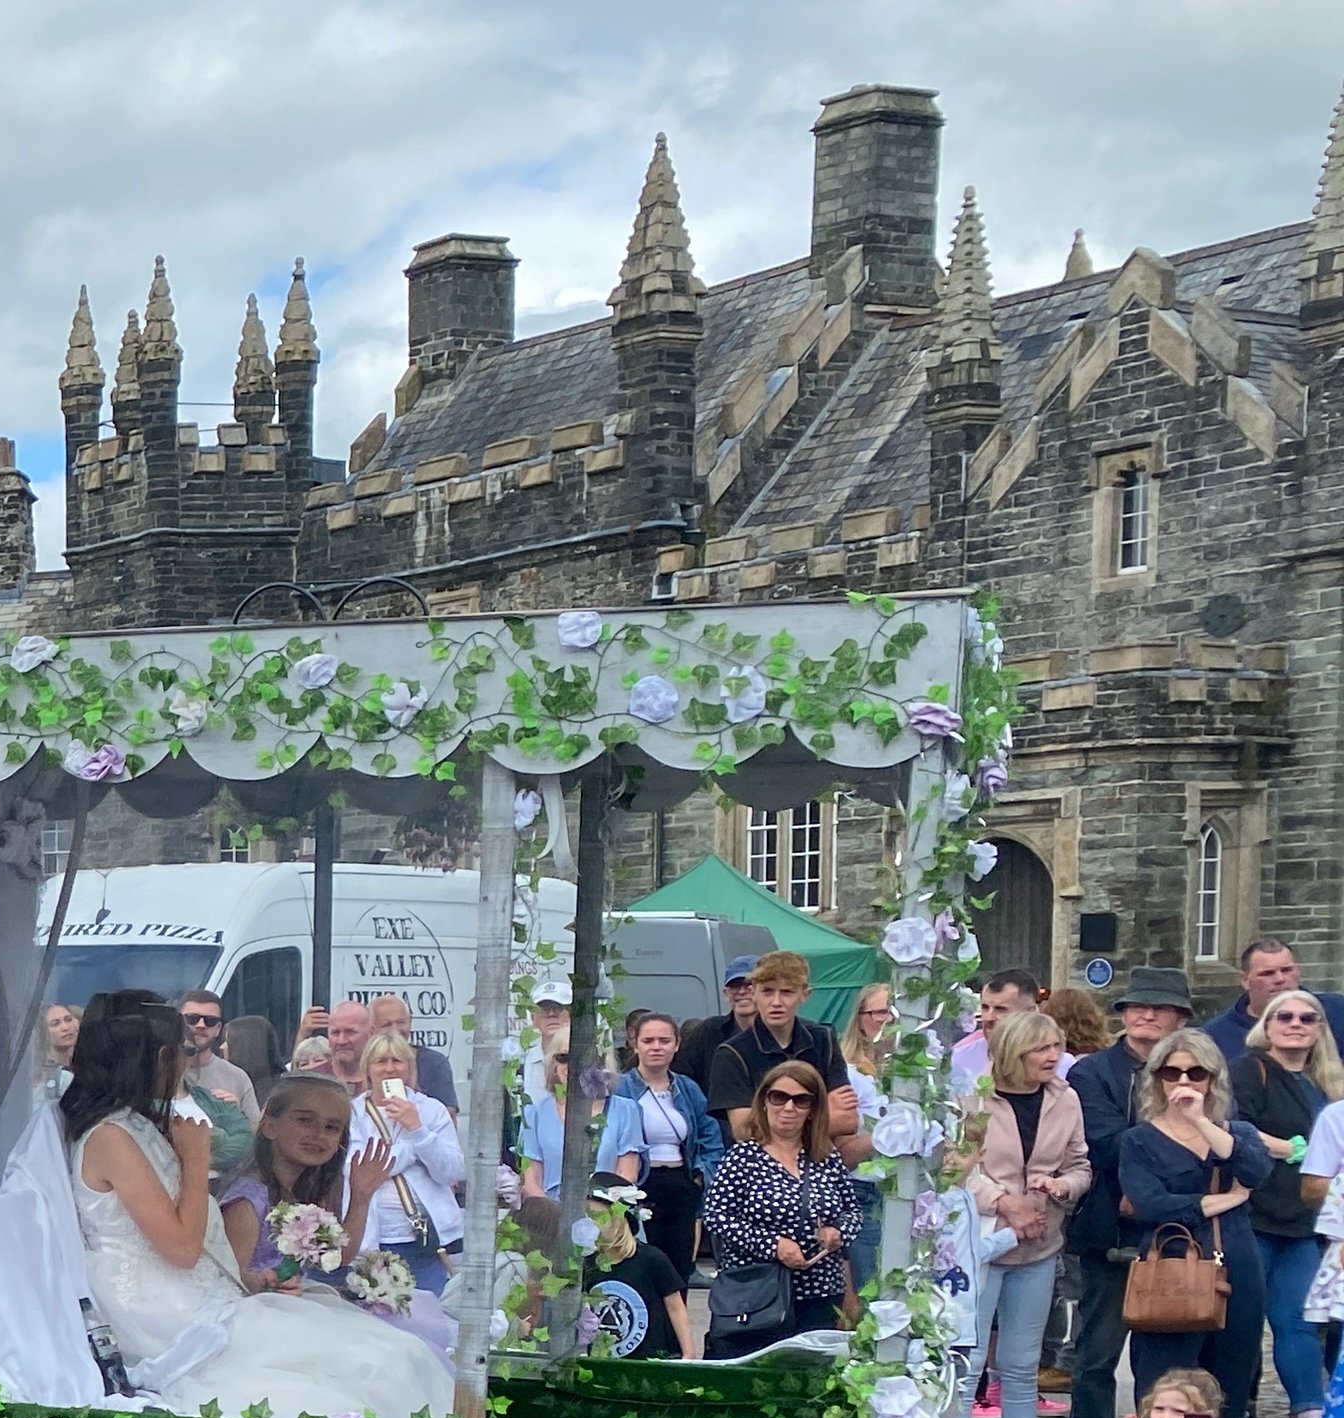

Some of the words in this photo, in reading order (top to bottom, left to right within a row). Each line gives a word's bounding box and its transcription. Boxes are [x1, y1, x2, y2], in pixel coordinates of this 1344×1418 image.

[63, 922, 133, 937] IRED
[138, 923, 226, 944] PIZZA
[372, 916, 415, 941] EXE
[354, 953, 436, 978] VALLEY
[418, 990, 452, 1016] CO.
[409, 1030, 448, 1047] IRED
